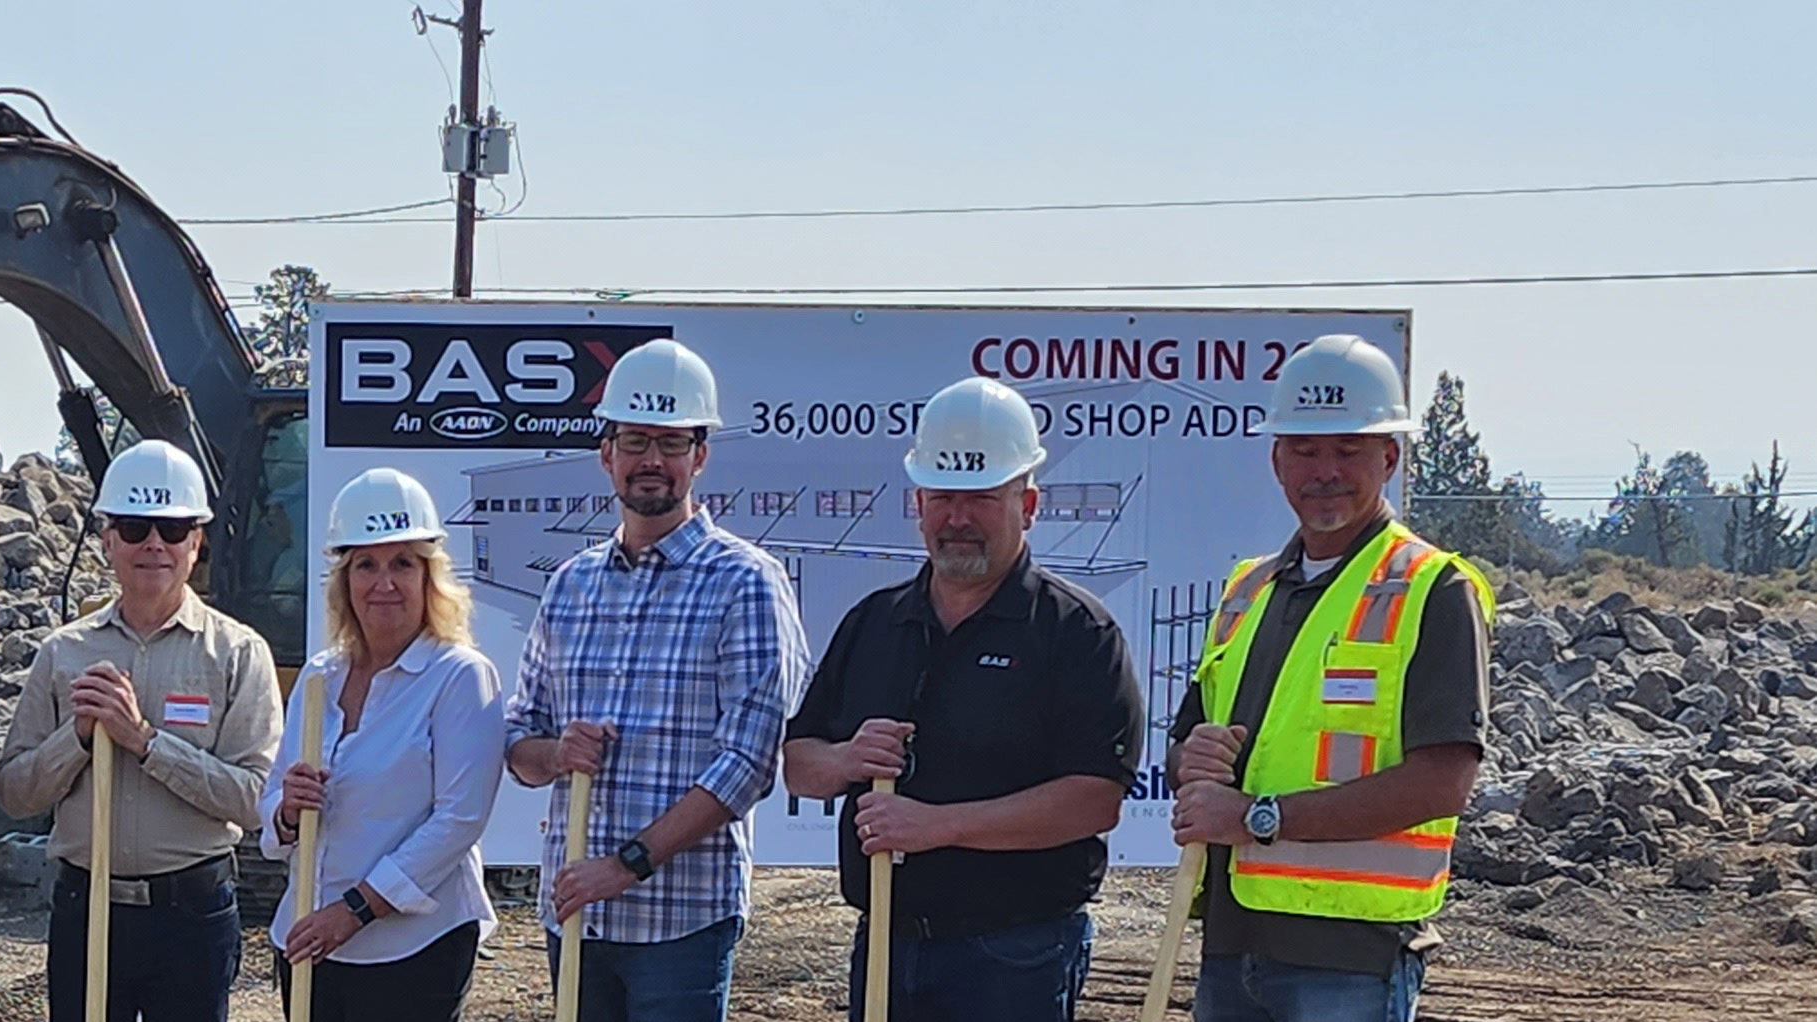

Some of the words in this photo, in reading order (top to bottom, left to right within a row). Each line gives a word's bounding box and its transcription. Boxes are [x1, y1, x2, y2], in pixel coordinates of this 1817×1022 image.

[971, 337, 1180, 380] COMING
[1197, 339, 1246, 381] IN
[393, 413, 422, 432] An
[514, 413, 607, 438] Company
[751, 401, 876, 440] 36,000
[1064, 402, 1171, 437] SHOP
[1182, 404, 1267, 437] ADD
